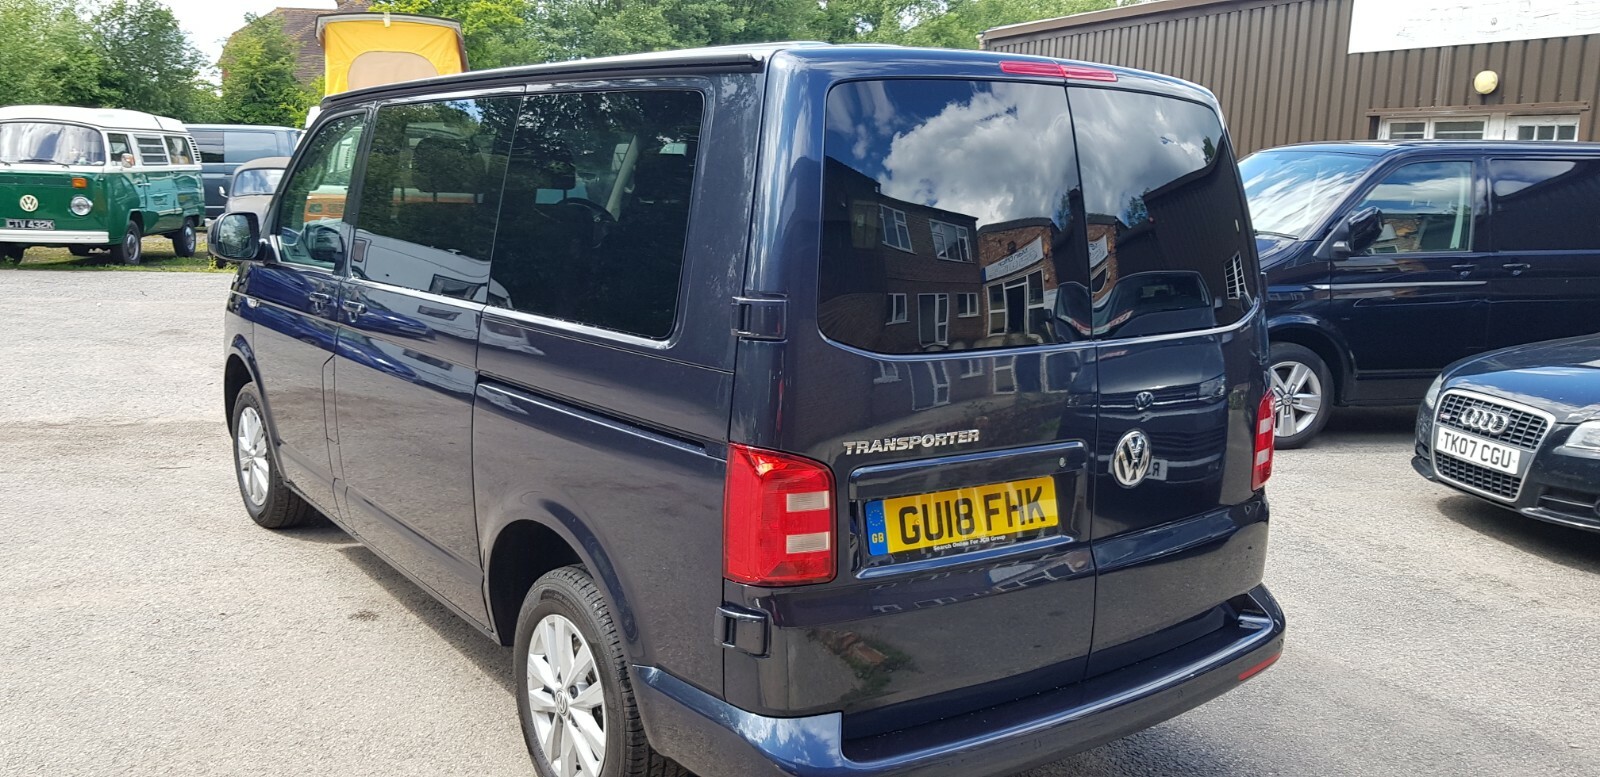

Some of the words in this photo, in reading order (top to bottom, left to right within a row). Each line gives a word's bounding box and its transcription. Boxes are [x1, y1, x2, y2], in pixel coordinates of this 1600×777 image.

[27, 220, 54, 229] 432K
[843, 429, 980, 455] TRANSPORTER
[1444, 432, 1477, 458] TK07
[1480, 444, 1512, 469] CGU
[898, 497, 975, 545] GU18
[983, 485, 1046, 531] FHK
[872, 532, 884, 543] GB
[933, 543, 952, 551] Search
